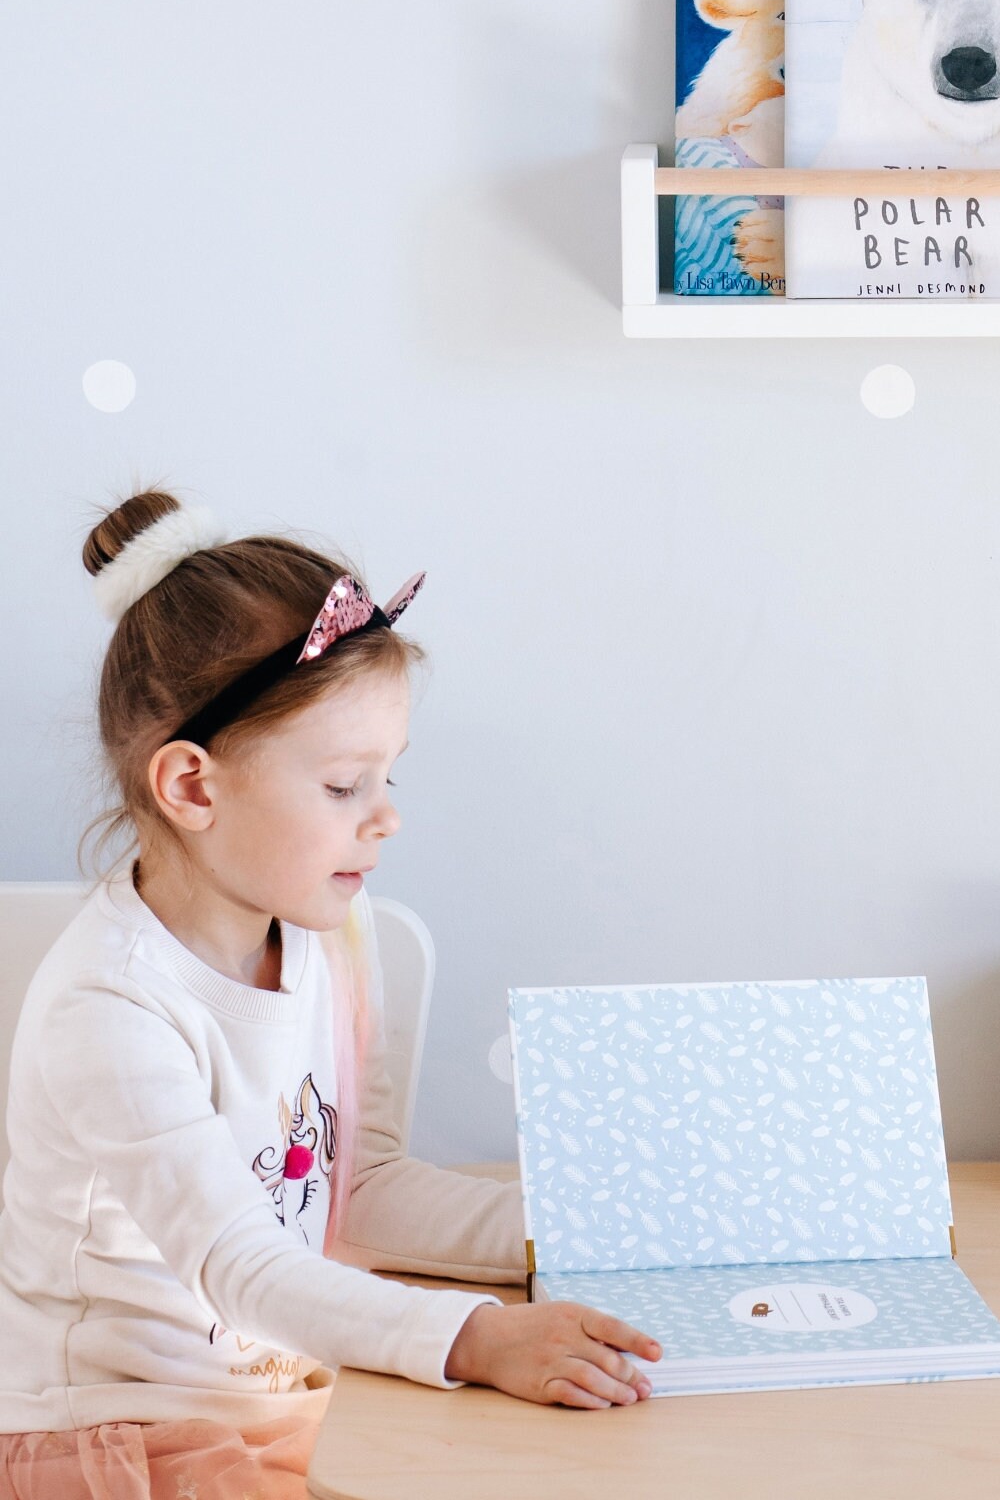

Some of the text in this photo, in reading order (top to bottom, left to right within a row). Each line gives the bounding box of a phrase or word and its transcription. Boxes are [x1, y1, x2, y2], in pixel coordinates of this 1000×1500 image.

[854, 197, 985, 230] POLAR
[864, 235, 973, 269] BEAR
[687, 272, 714, 290] Lisa
[718, 272, 755, 290] Tawn
[760, 272, 785, 292] Ber
[857, 283, 985, 296] JENNI DESMOND
